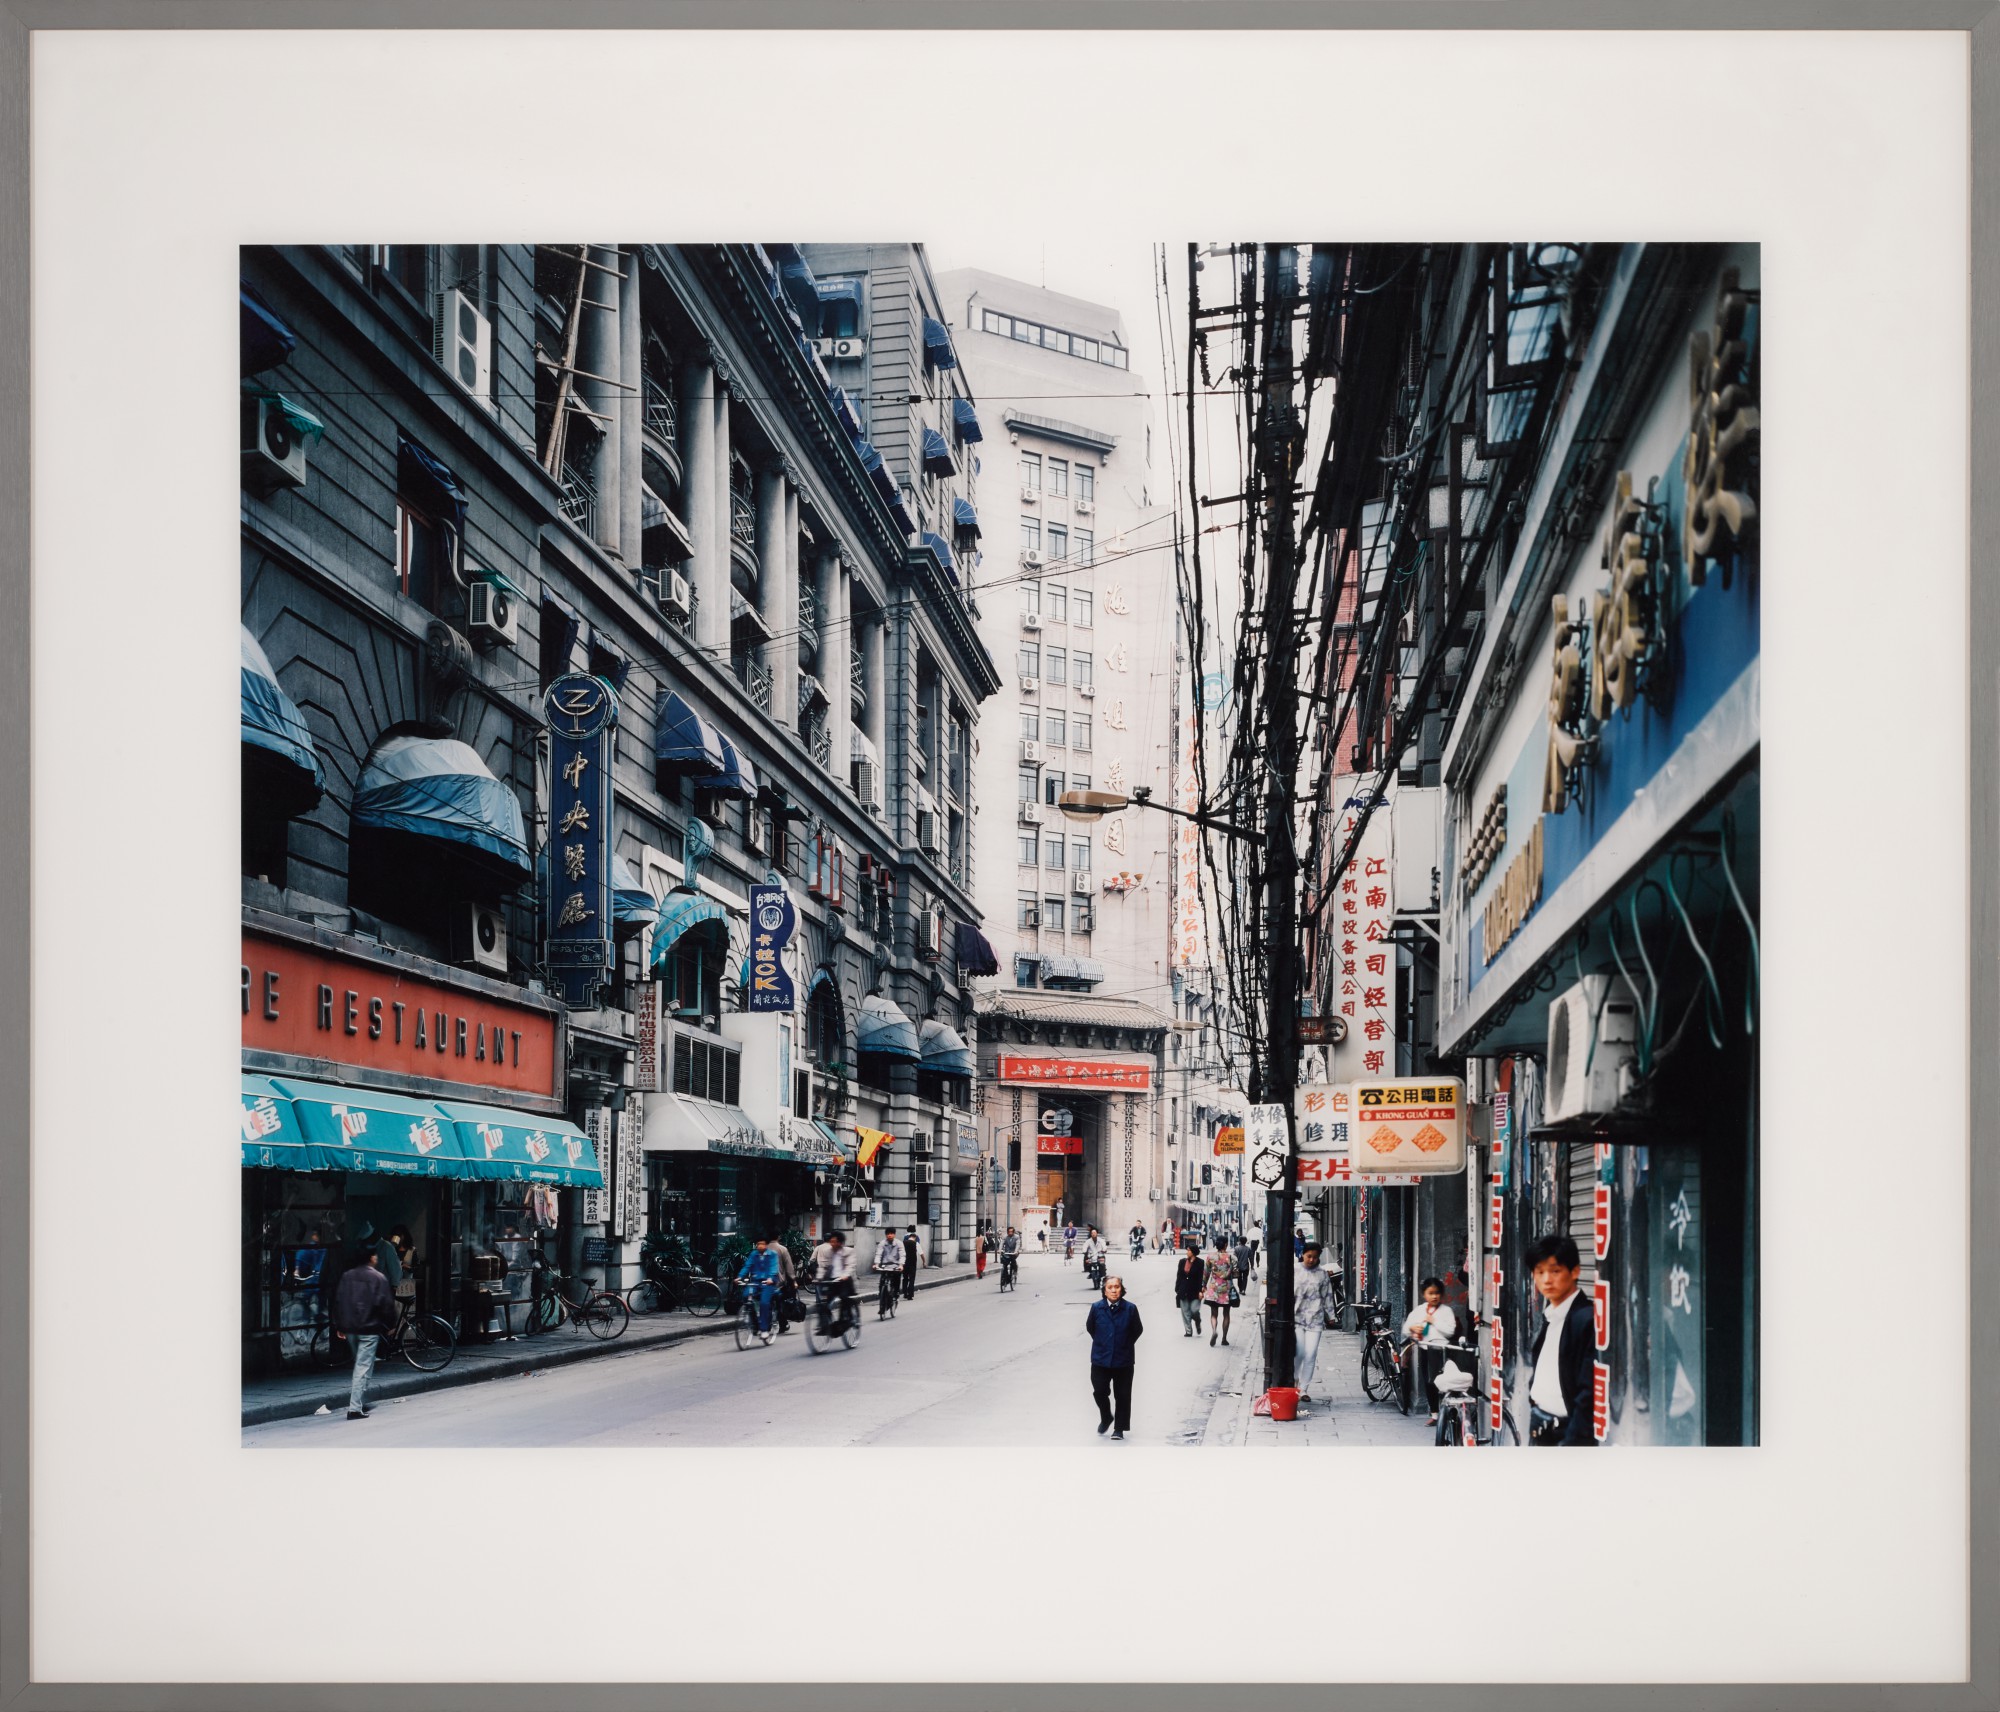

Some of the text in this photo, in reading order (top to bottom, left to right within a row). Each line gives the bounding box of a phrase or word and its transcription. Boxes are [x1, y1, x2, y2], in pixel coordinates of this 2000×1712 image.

[1363, 857, 1389, 1075] 江南公司经营部
[317, 983, 522, 1068] RESTAURANT
[1304, 1092, 1348, 1112] 彩色
[1386, 1087, 1453, 1104] 公用電話
[331, 1104, 367, 1146] 7UP
[1375, 1112, 1406, 1120] KHONG
[1406, 1110, 1430, 1119] GUAN
[477, 1123, 503, 1159] 7UP
[562, 1136, 583, 1167] 7UP
[1297, 1158, 1350, 1182] 名片
